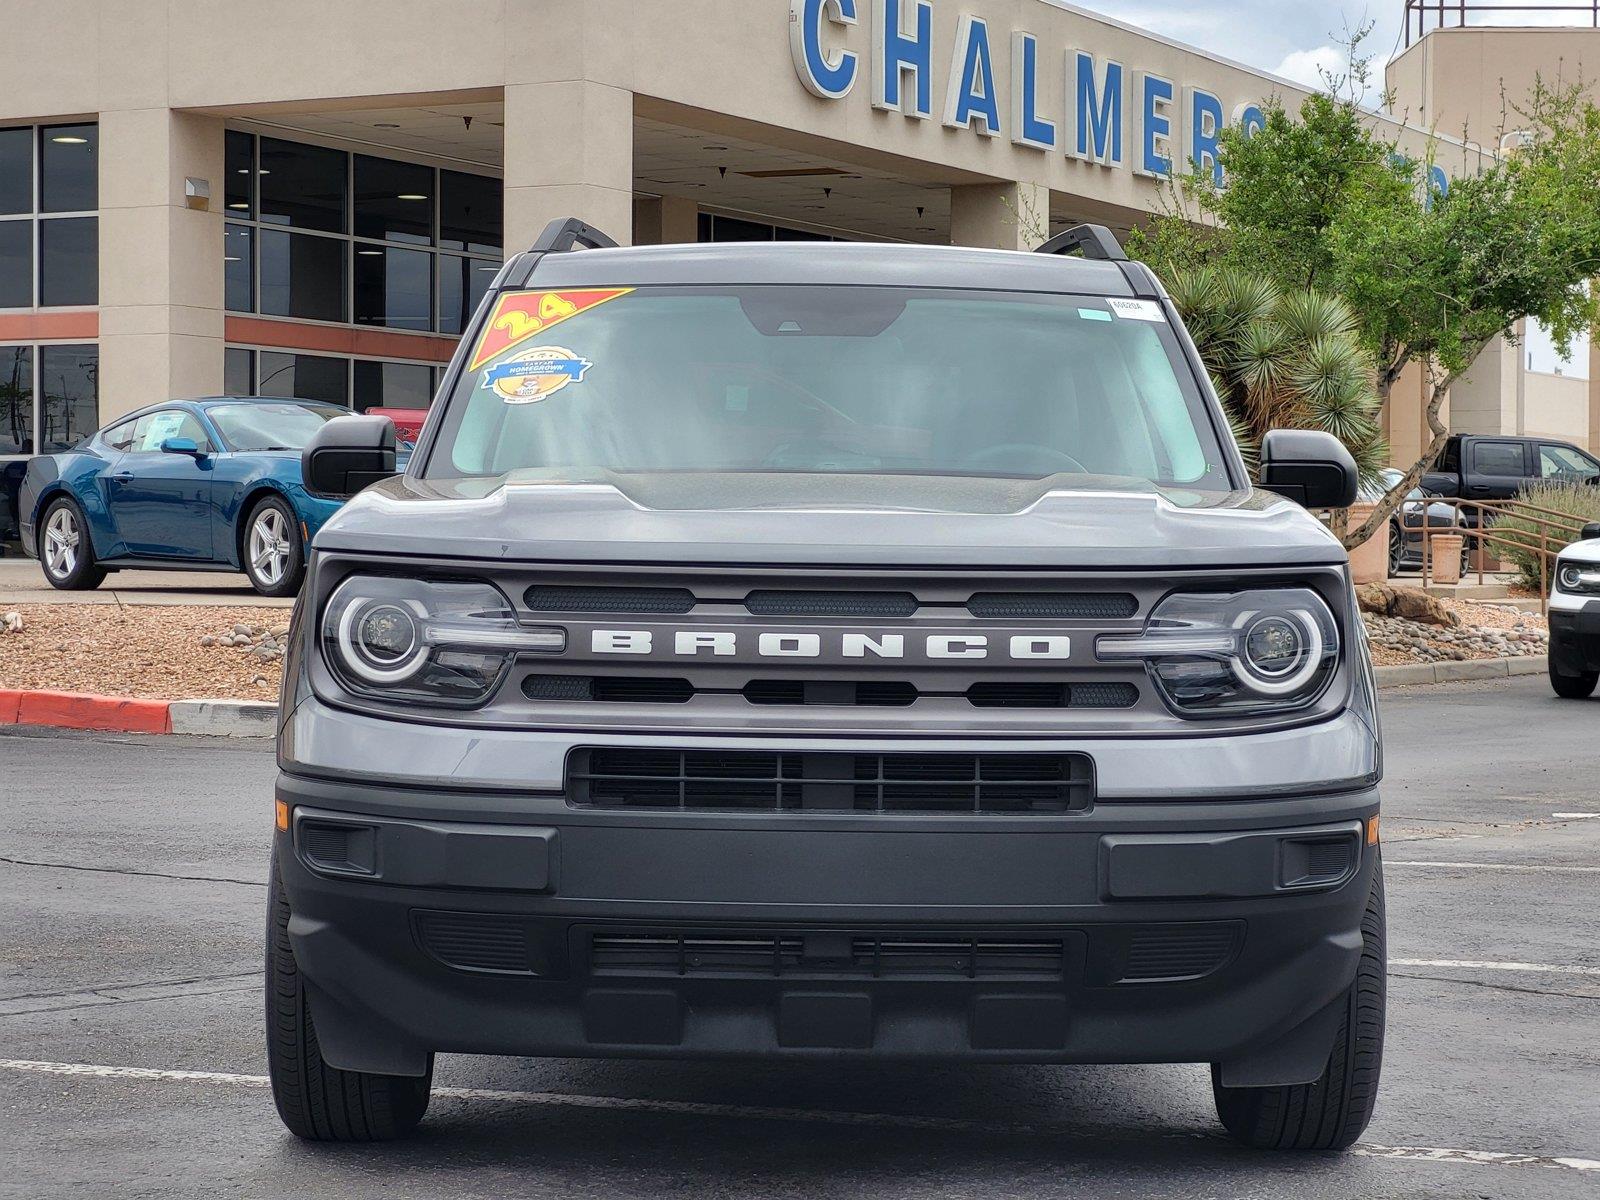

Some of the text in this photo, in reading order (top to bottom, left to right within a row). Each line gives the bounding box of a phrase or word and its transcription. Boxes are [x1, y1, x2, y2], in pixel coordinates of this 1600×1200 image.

[494, 292, 578, 339] 24
[509, 363, 565, 374] HOMEGROWN
[591, 628, 1071, 659] BRONCO
